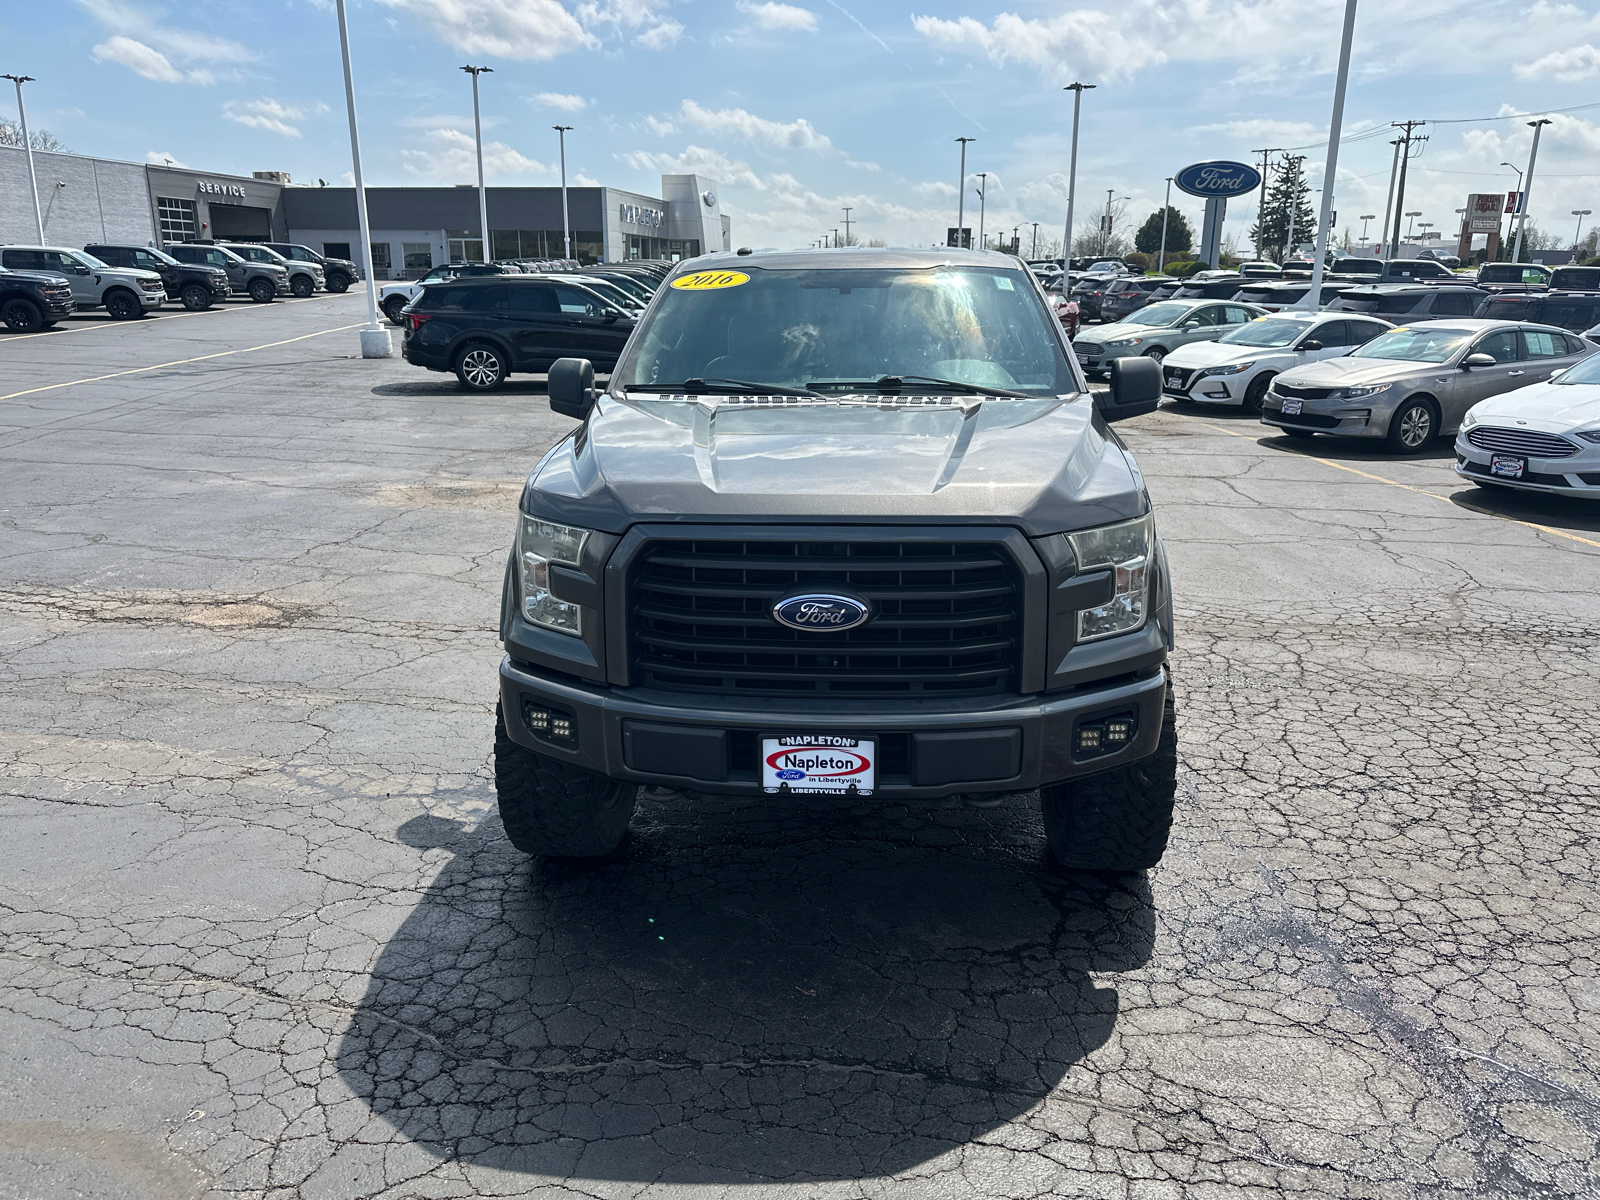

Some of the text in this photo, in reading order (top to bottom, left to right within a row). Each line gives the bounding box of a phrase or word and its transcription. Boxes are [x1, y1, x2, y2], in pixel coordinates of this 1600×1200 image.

[1195, 167, 1245, 189] Ford
[199, 182, 246, 197] SERVICE
[620, 203, 665, 228] NAPLETON
[1475, 203, 1500, 213] SQUARE
[682, 273, 736, 287] 2016
[795, 602, 846, 624] Ford
[786, 736, 851, 747] NAPLETON
[784, 754, 854, 771] Napleton
[781, 770, 801, 779] Ford
